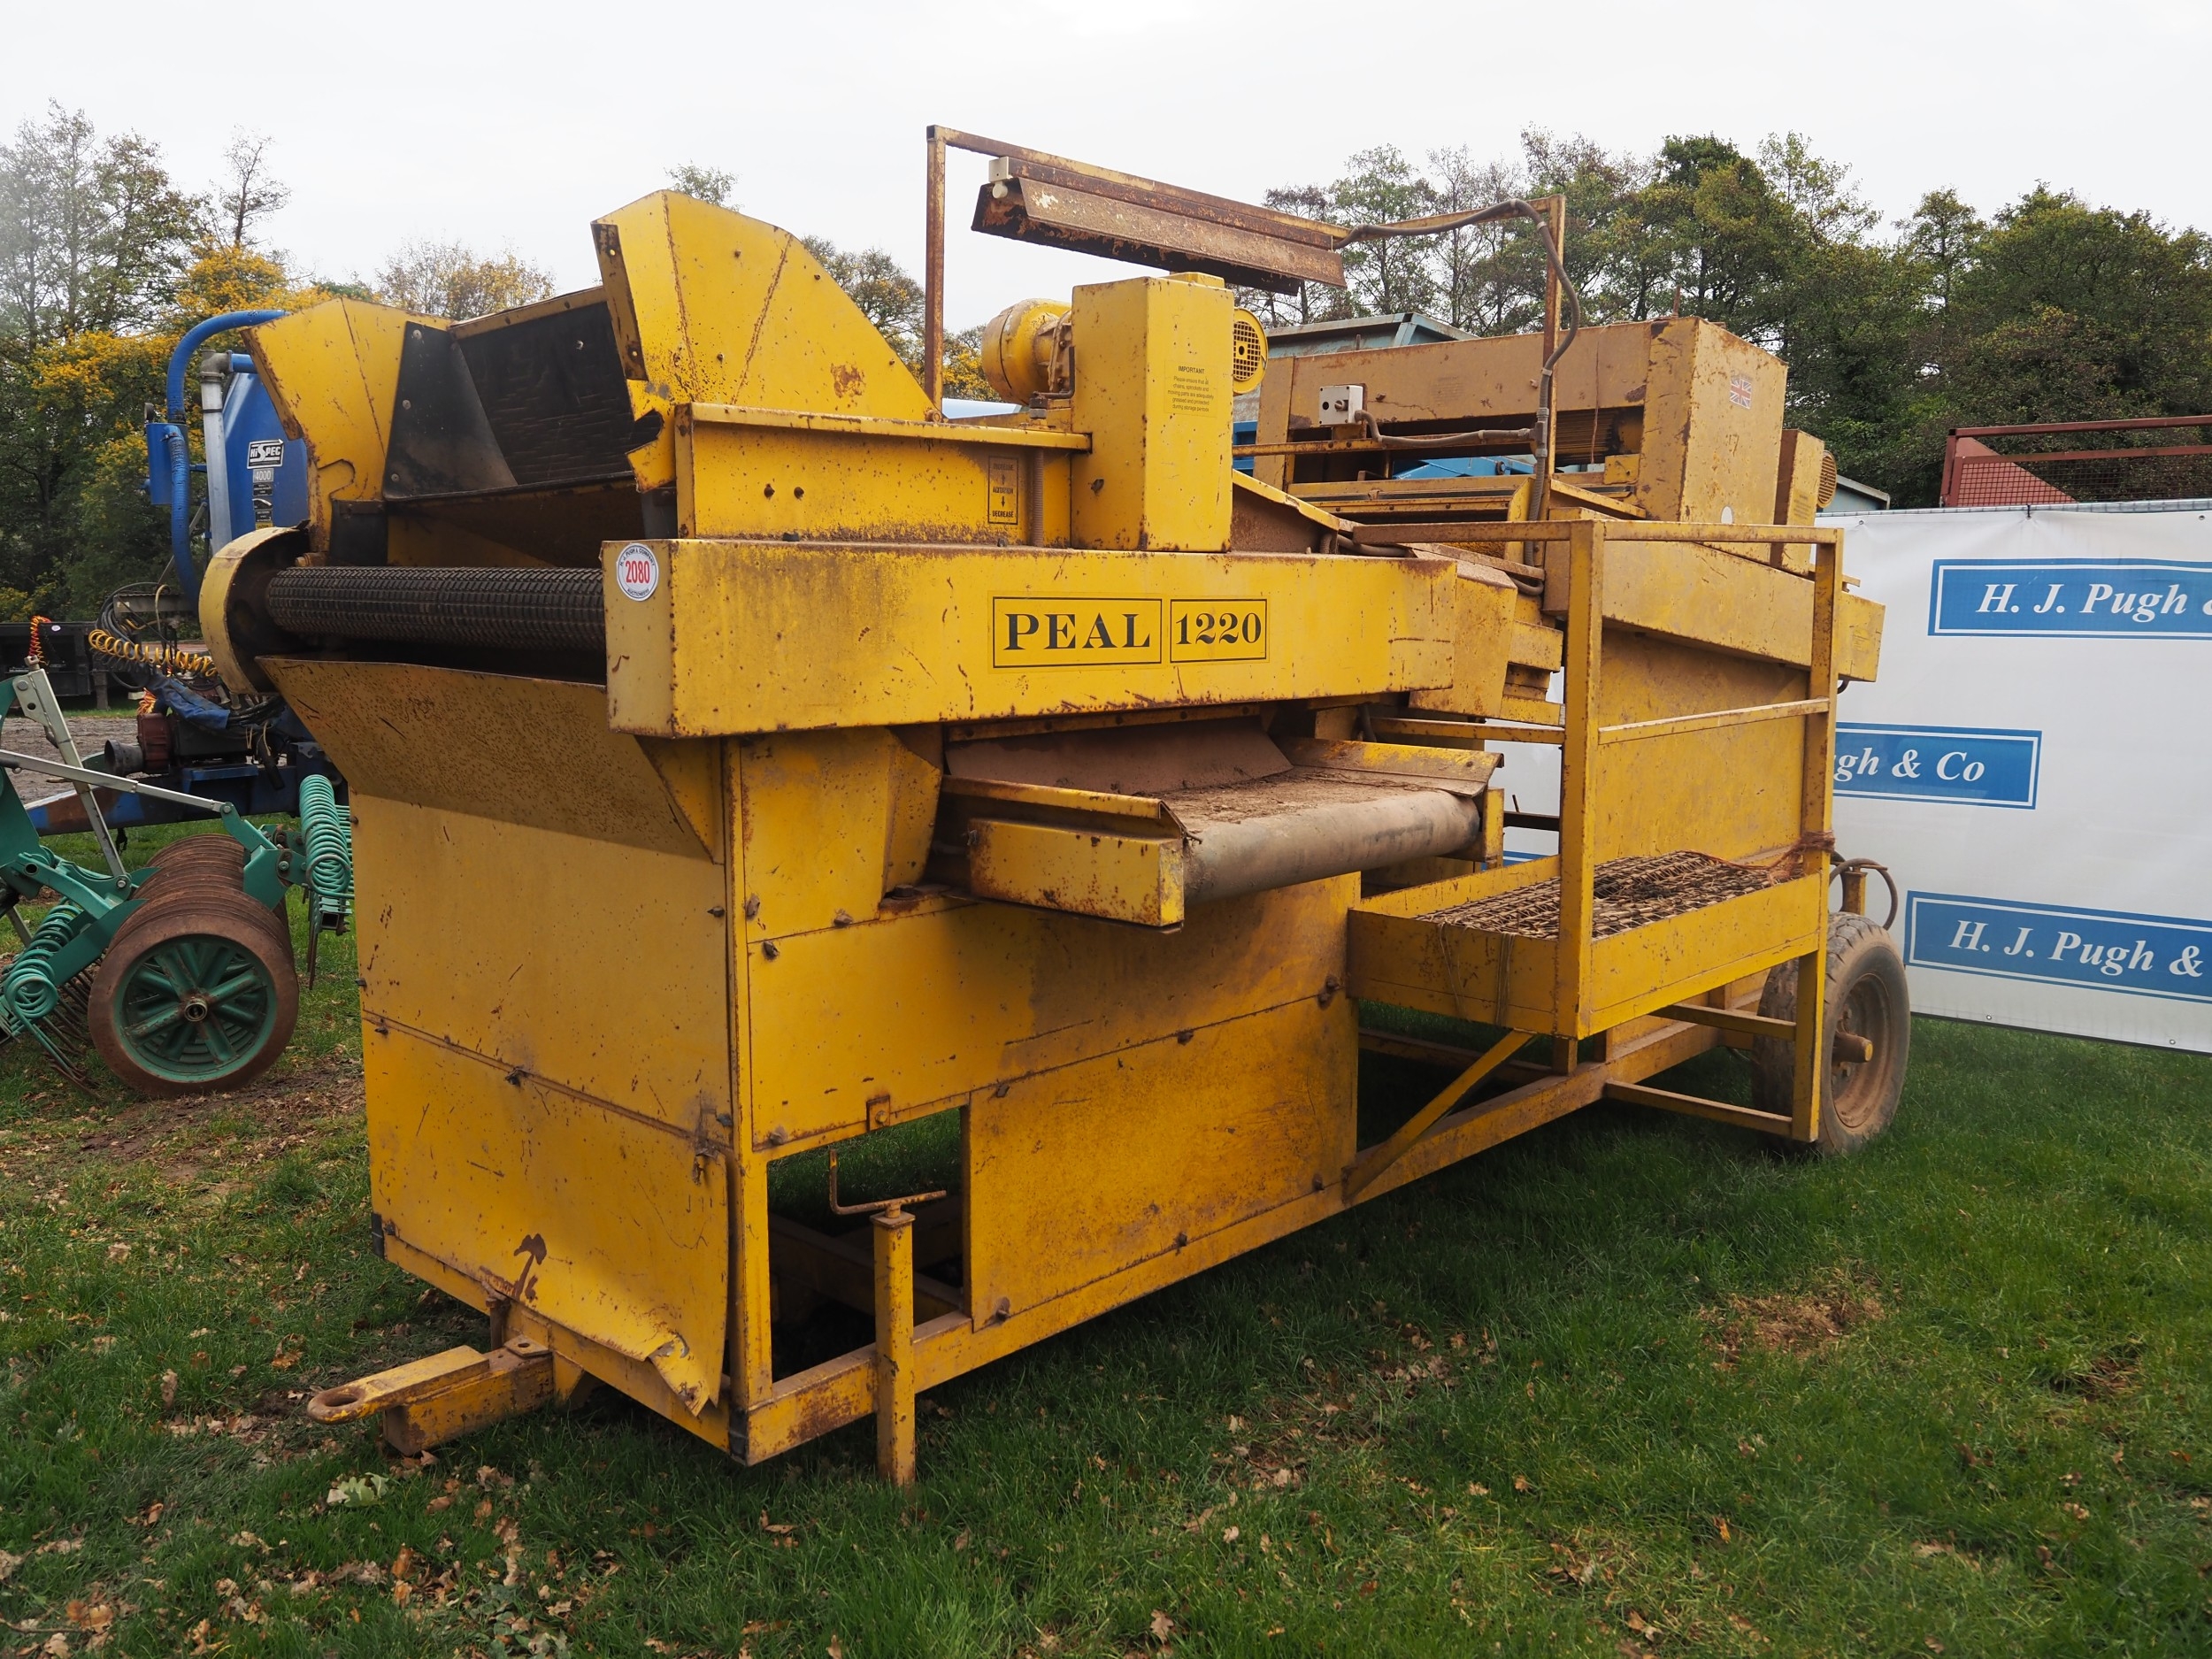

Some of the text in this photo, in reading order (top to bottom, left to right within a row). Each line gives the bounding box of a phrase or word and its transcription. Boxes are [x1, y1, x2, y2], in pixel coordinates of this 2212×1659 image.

[1178, 365, 1204, 374] IMPORTANT
[255, 470, 272, 480] 4000
[626, 560, 650, 583] 2080
[1975, 583, 2021, 614] H.
[2032, 583, 2066, 614] J.
[2078, 583, 2189, 623] Pugh
[1002, 612, 1263, 650] PEAL 1220
[1833, 747, 1985, 782] gh & Co
[1947, 919, 2204, 978] H. J. Pugh &
